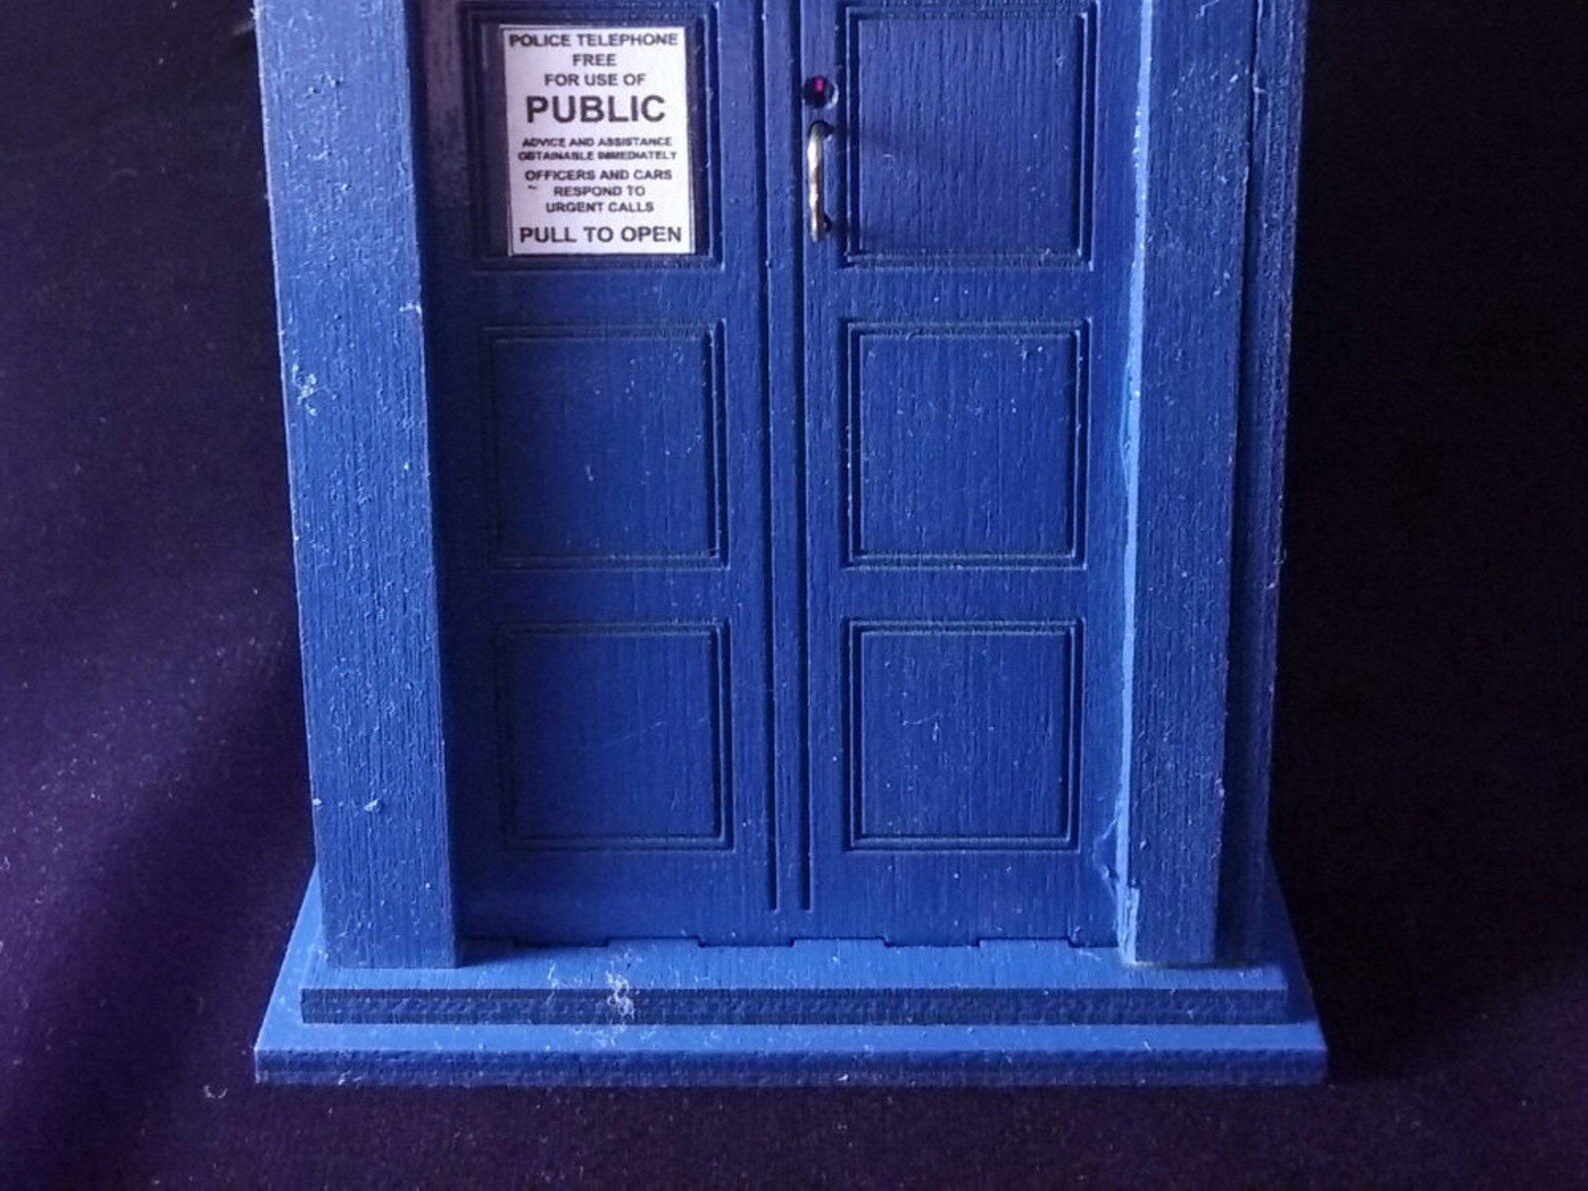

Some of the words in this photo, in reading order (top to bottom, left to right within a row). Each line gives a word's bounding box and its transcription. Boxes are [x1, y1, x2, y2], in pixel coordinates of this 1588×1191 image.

[510, 34, 571, 47] POLICE
[577, 33, 678, 46] TELEPHONE
[573, 53, 617, 66] FREE
[545, 74, 579, 86] FOR
[585, 74, 618, 86] USE
[623, 73, 646, 86] OF
[526, 95, 665, 123] PUBLIC
[522, 138, 565, 147] ADVICE
[569, 138, 594, 147] AND
[598, 137, 672, 146] ASSISTANCE
[518, 151, 594, 160] OBTAINABLE
[598, 151, 677, 160] IMMEDIATELY
[525, 170, 595, 181] OFFICERS
[600, 170, 629, 180] AND
[634, 169, 672, 180] CARS
[554, 186, 622, 196] RESPOND
[627, 185, 645, 196] TO
[546, 202, 604, 213] URGENT
[608, 202, 654, 212] CALLS
[520, 227, 576, 243] PULL
[584, 227, 614, 242] TO
[621, 227, 682, 242] OPEN
